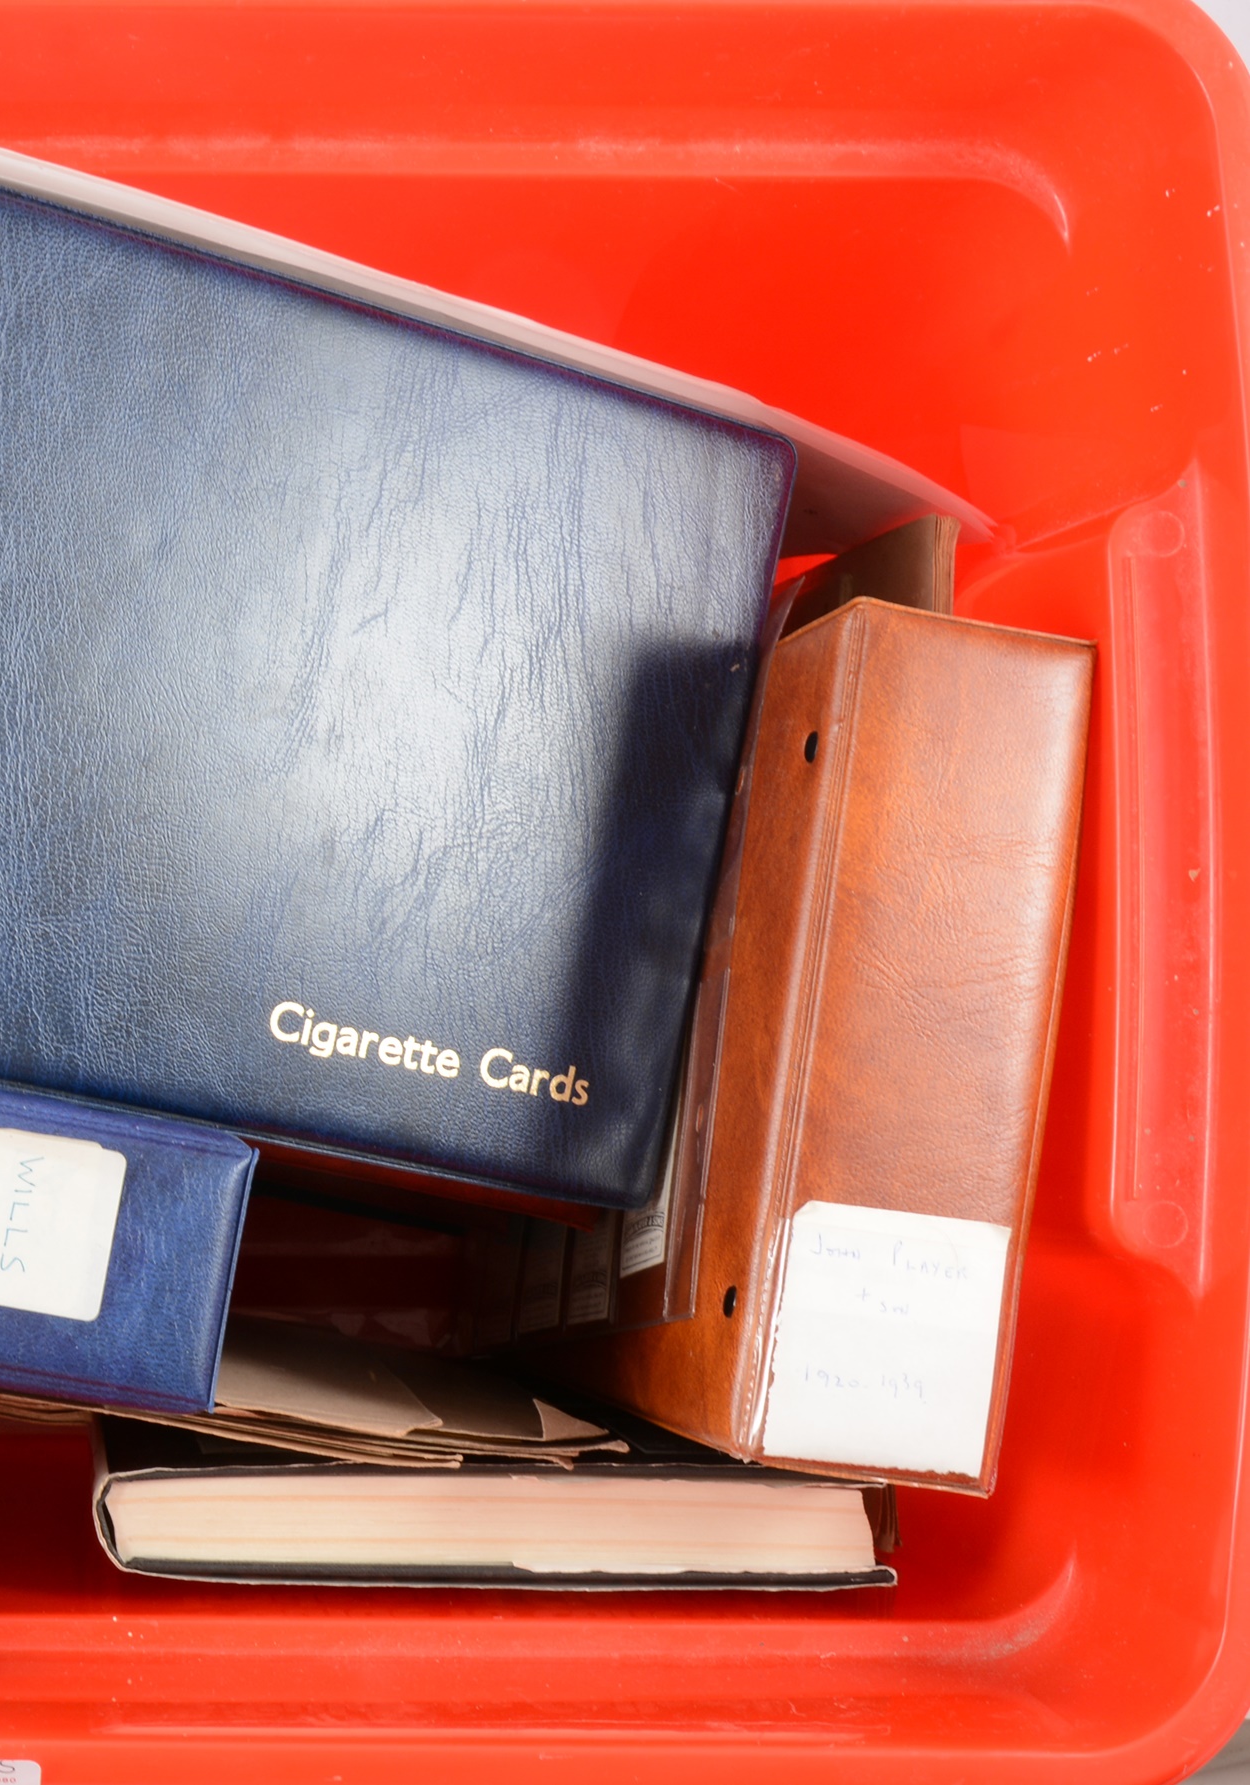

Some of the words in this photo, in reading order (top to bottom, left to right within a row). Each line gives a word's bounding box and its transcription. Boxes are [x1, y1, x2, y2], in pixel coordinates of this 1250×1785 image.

[269, 1001, 461, 1077] Cigarette
[480, 1047, 590, 1105] Cards
[0, 1156, 45, 1273] WILLS
